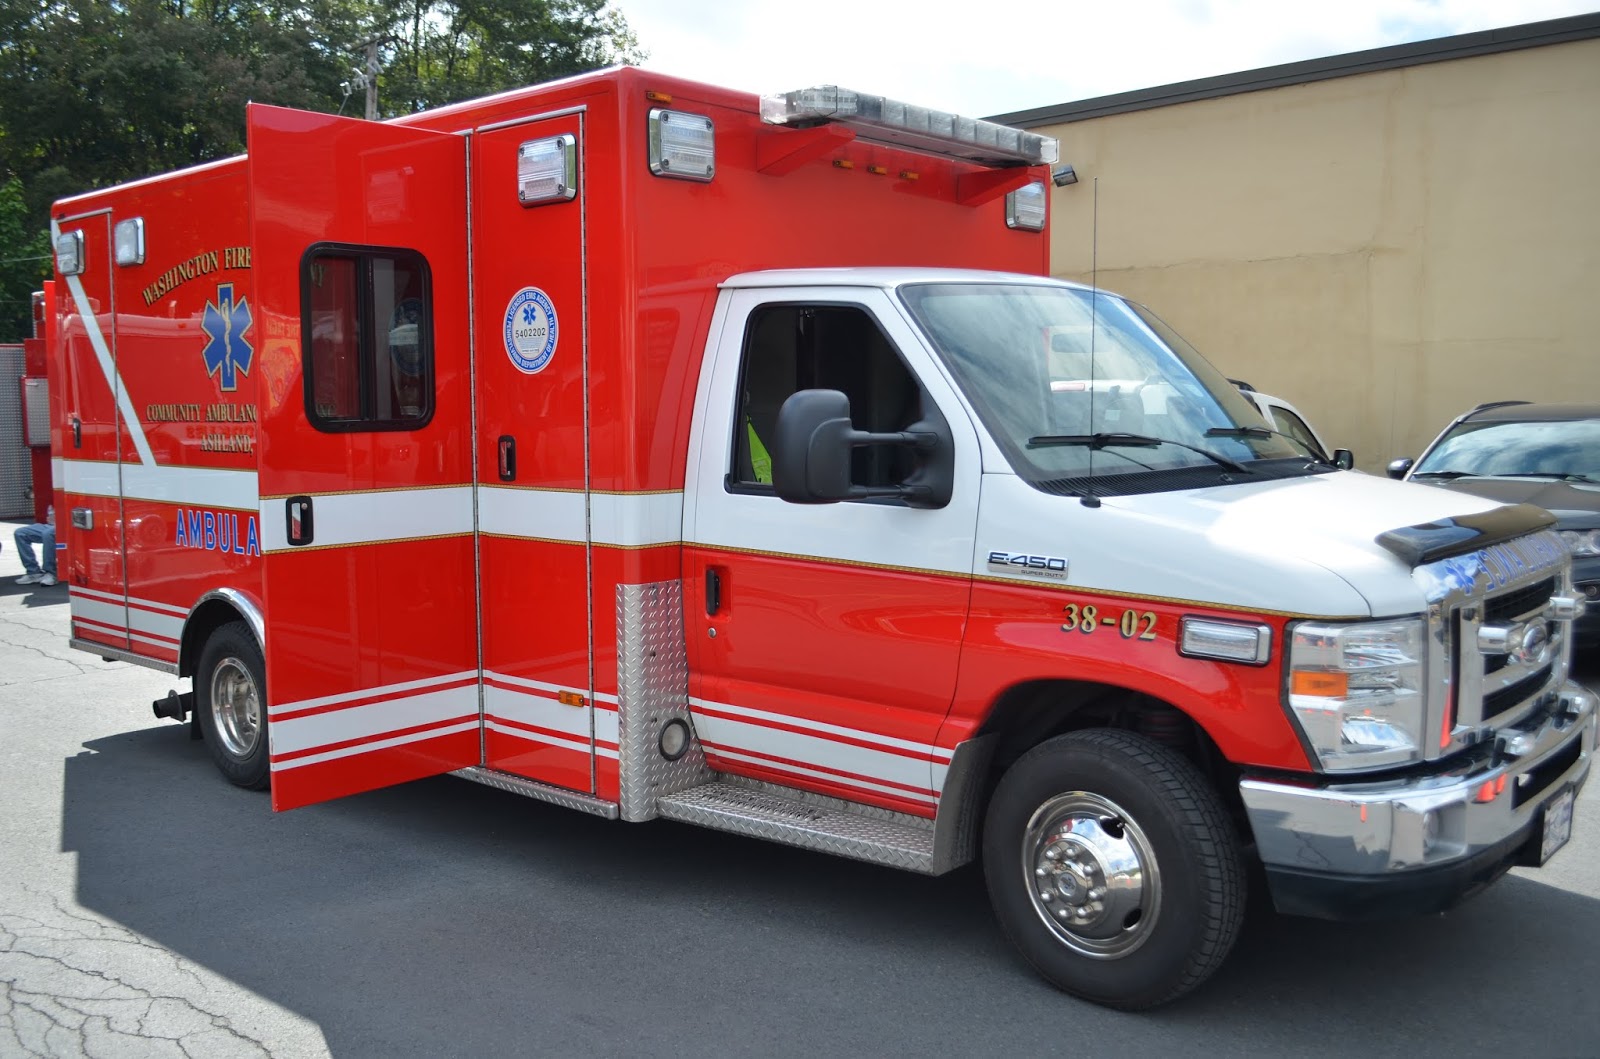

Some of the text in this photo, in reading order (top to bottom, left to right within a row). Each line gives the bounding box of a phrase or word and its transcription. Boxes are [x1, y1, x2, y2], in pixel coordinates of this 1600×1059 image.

[142, 247, 251, 307] WASHINGTON FIRE
[525, 292, 537, 300] EMS
[536, 294, 552, 316] AGENCY
[515, 327, 546, 338] 5402202
[146, 404, 200, 422] COMMUNITY
[176, 508, 260, 557] AMBULA
[988, 551, 1066, 571] E-450
[1061, 603, 1157, 641] 38-02
